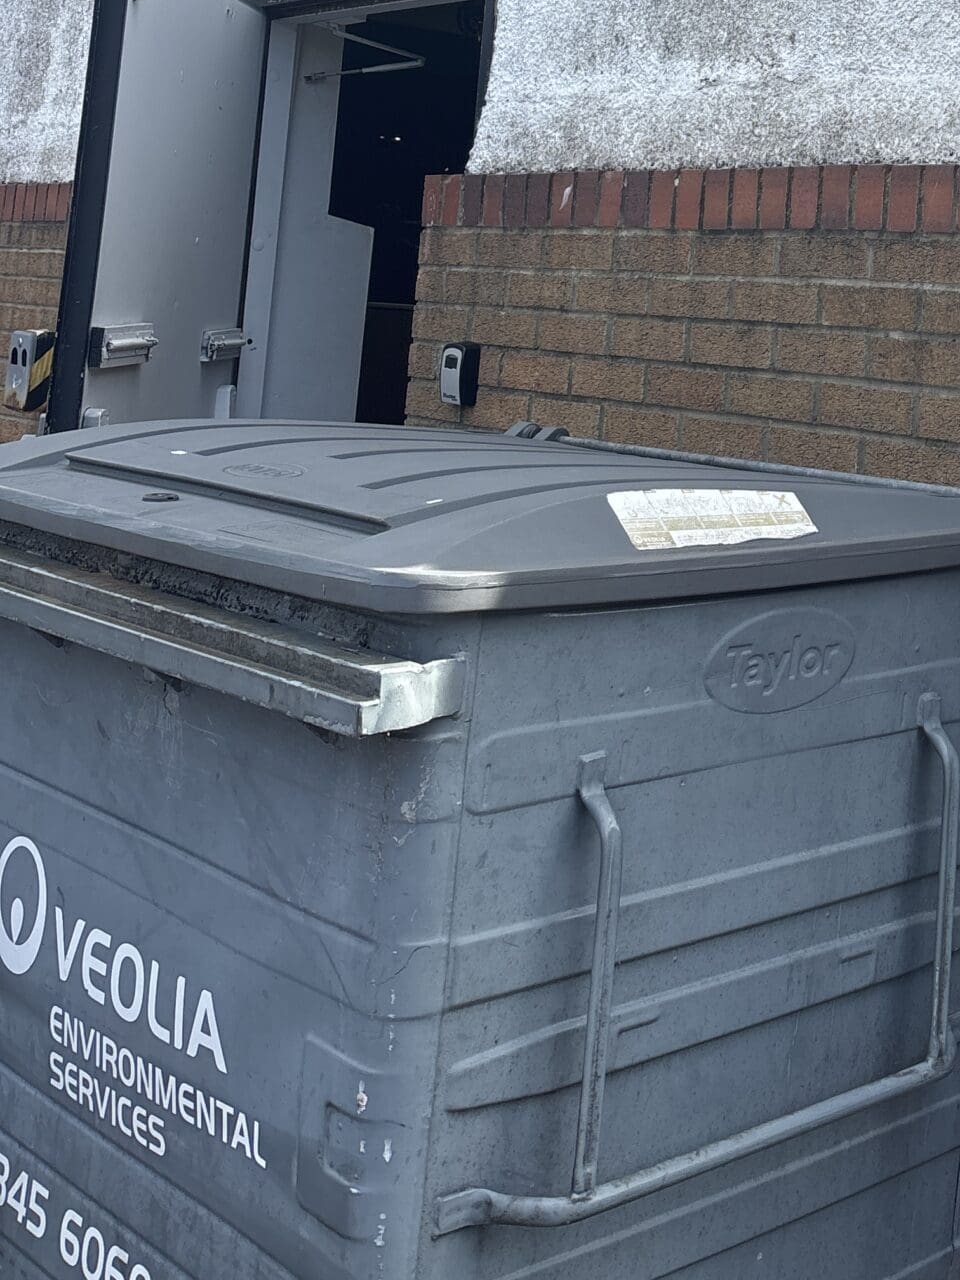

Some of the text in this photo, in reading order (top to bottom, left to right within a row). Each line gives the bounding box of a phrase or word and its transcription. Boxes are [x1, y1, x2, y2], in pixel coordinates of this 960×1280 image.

[726, 634, 841, 697] Taylor
[55, 906, 228, 1074] VEOLIA
[49, 1052, 166, 1157] SERVICES
[50, 1005, 267, 1169] ENVIRONMENTAL
[59, 1209, 152, 1280] 606
